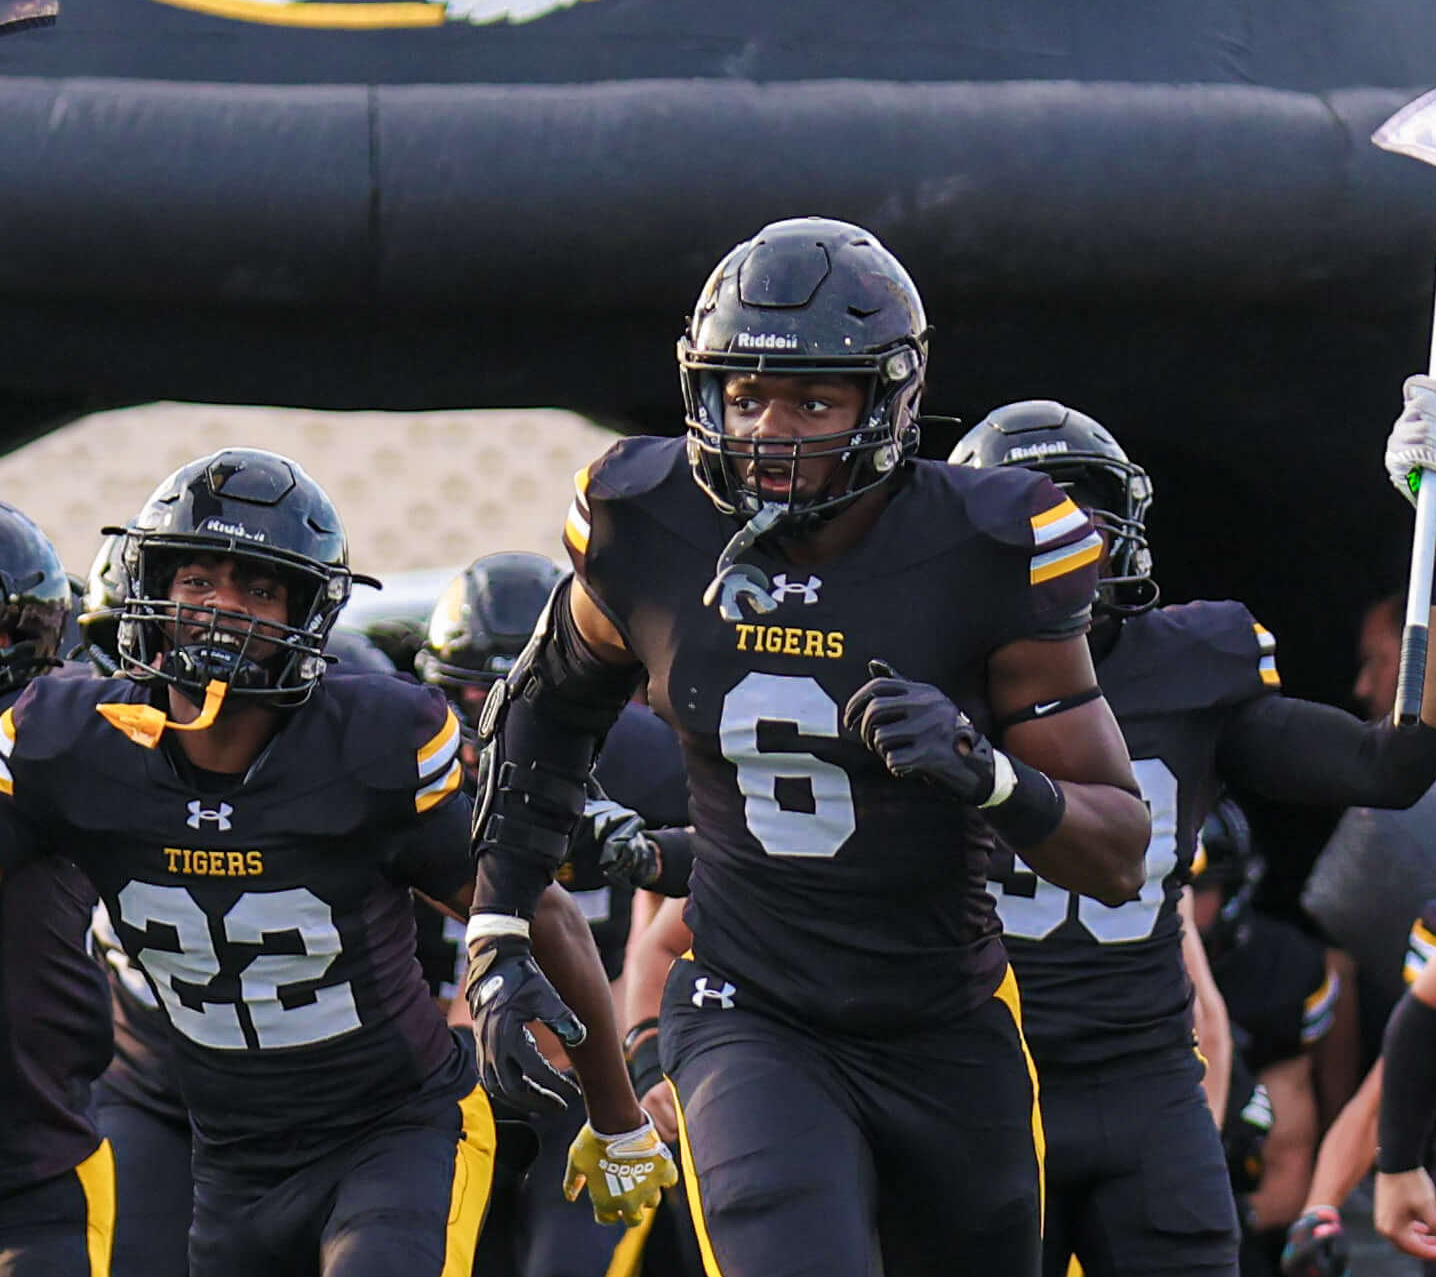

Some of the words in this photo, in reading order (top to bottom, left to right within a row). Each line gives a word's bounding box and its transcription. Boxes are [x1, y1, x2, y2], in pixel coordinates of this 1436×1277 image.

[737, 332, 798, 349] Riddell
[1010, 441, 1068, 460] Riddell
[735, 623, 845, 658] TIGERS
[719, 671, 857, 858] 6
[163, 847, 264, 876] TIGERS
[118, 879, 363, 1050] 22
